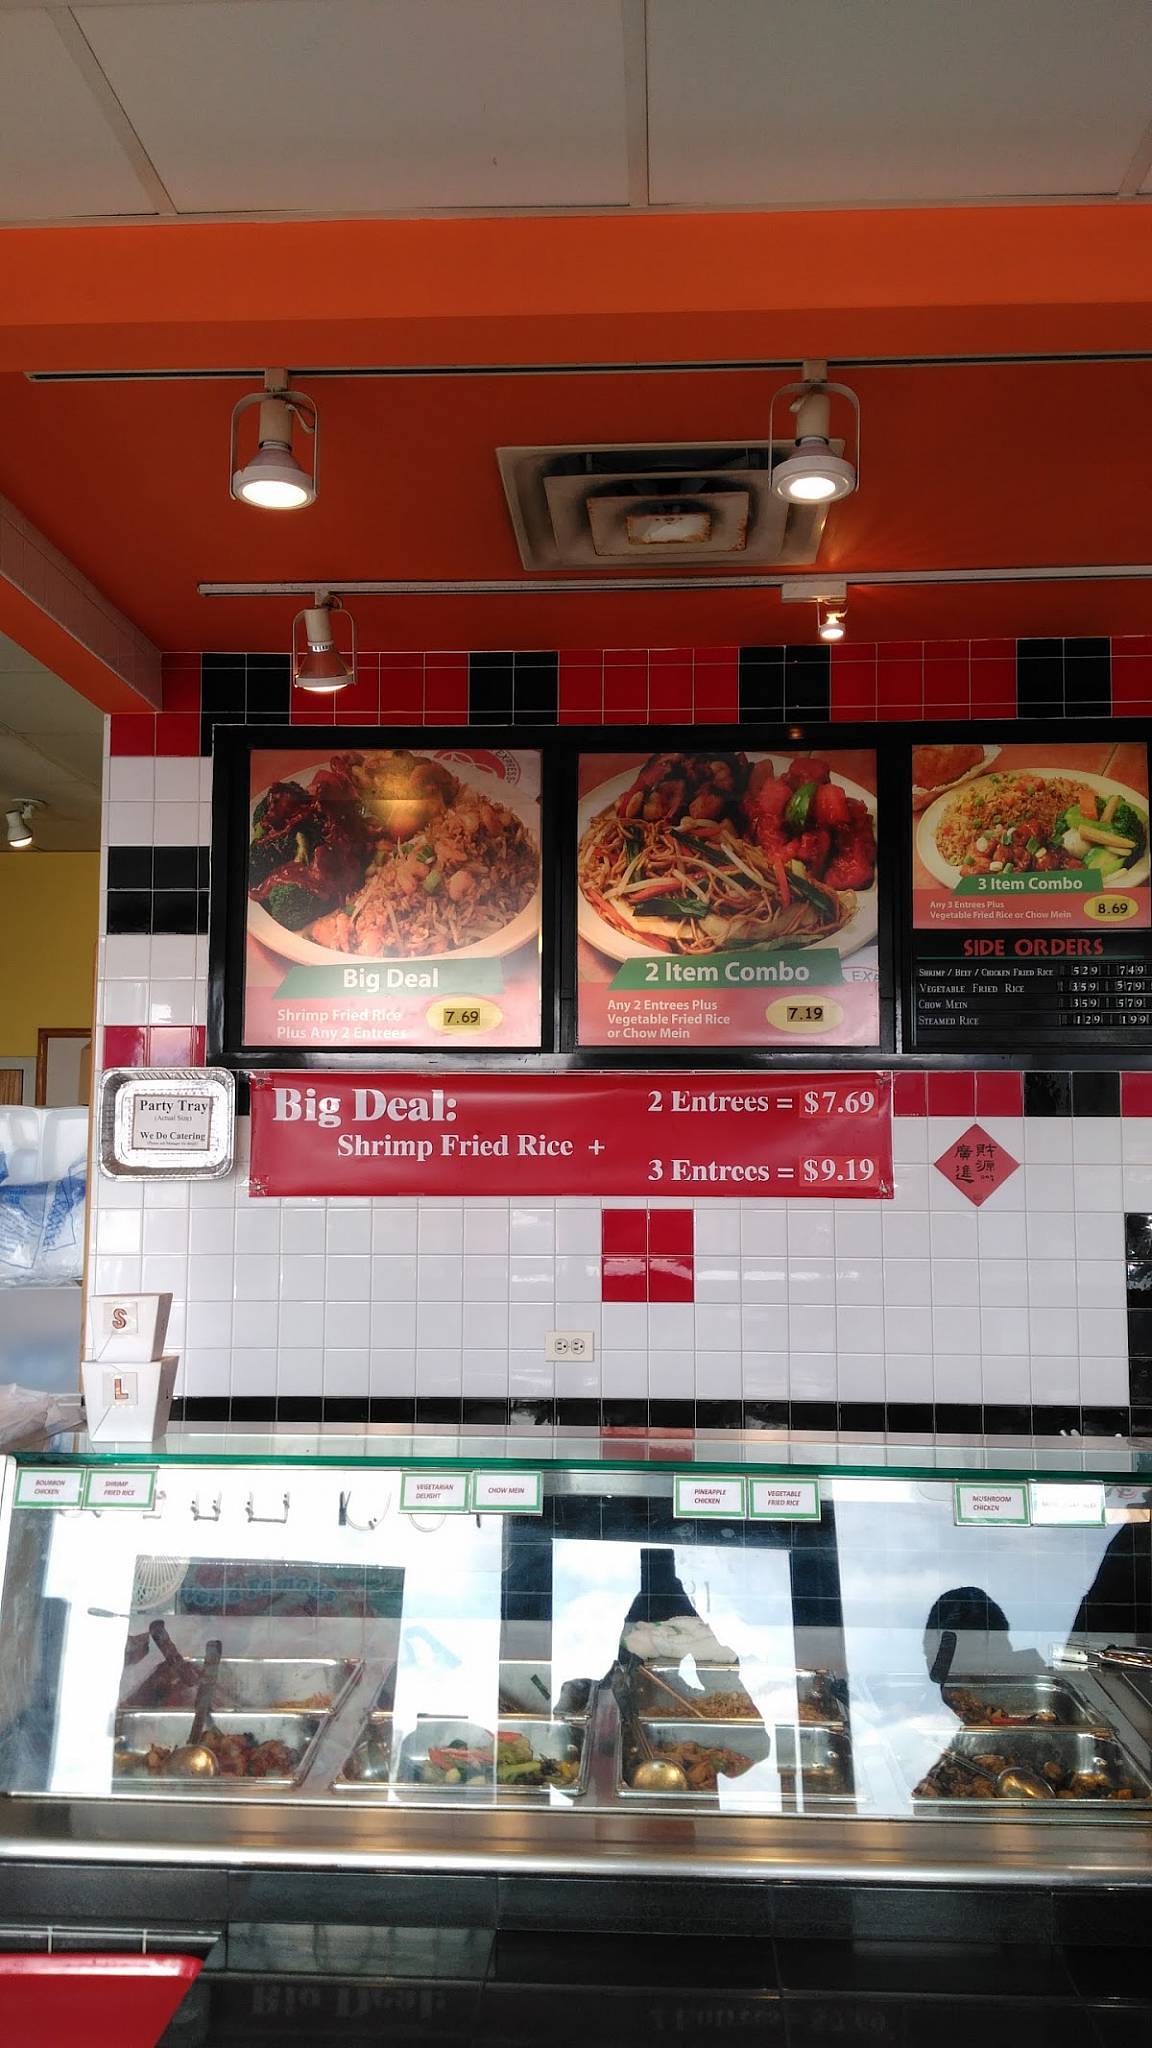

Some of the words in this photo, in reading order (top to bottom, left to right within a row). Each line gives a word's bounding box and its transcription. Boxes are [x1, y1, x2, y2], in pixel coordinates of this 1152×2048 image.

[978, 878, 987, 890] 3
[991, 879, 1023, 890] Item
[1028, 878, 1083, 890] Combo
[930, 901, 948, 910] Any
[948, 901, 953, 909] 3
[955, 901, 986, 909] Entrees
[987, 901, 1004, 909] Plus
[1098, 903, 1128, 914] 8.69
[930, 911, 972, 920] Vegetable
[973, 911, 994, 919] Fried
[996, 911, 1013, 919] Rice
[1025, 911, 1048, 919] Chow
[1050, 911, 1072, 919] Mein
[963, 939, 1005, 956] SIDE
[1014, 938, 1103, 956] ORDERS
[645, 962, 659, 982] 2
[666, 962, 718, 982] Item
[725, 961, 810, 982] Combo
[343, 968, 380, 993] Big
[387, 967, 440, 988] Deal
[607, 1000, 632, 1012] Any
[634, 1000, 641, 1010] 2
[644, 1000, 690, 1011] Entrees
[692, 1000, 718, 1010] Plus
[788, 1006, 823, 1020] 7.19
[277, 1008, 329, 1024] Shrimp
[332, 1008, 368, 1022] Fried
[372, 1008, 401, 1022] Rice
[445, 1010, 479, 1024] 7.69
[607, 1014, 669, 1026] Vegetable
[671, 1014, 703, 1025] Fried
[705, 1014, 731, 1025] Rice
[276, 1026, 306, 1040] Plus
[310, 1027, 337, 1042] Any
[342, 1028, 349, 1040] 2
[354, 1027, 408, 1040] Entrees
[607, 1030, 621, 1038] or
[623, 1028, 657, 1039] Chow
[660, 1028, 690, 1039] Mein
[140, 1100, 174, 1114] Party
[178, 1100, 208, 1114] Tray
[271, 1087, 342, 1128] Big
[351, 1088, 457, 1122] Deal:
[648, 1090, 663, 1112] 2
[671, 1090, 769, 1112] Entrees
[776, 1098, 793, 1109] =
[804, 1090, 875, 1114] $7.69
[140, 1131, 154, 1140] We
[156, 1131, 168, 1140] Do
[170, 1132, 206, 1141] Catering
[337, 1134, 433, 1162] Shrimp
[440, 1134, 509, 1157] Fried
[516, 1134, 574, 1157] Rice
[588, 1139, 606, 1156] +
[648, 1160, 664, 1181] 3
[671, 1160, 770, 1182] Entrees
[777, 1167, 794, 1178] =
[803, 1158, 875, 1182] $9.19
[112, 1308, 127, 1330] S
[114, 1378, 129, 1400] L
